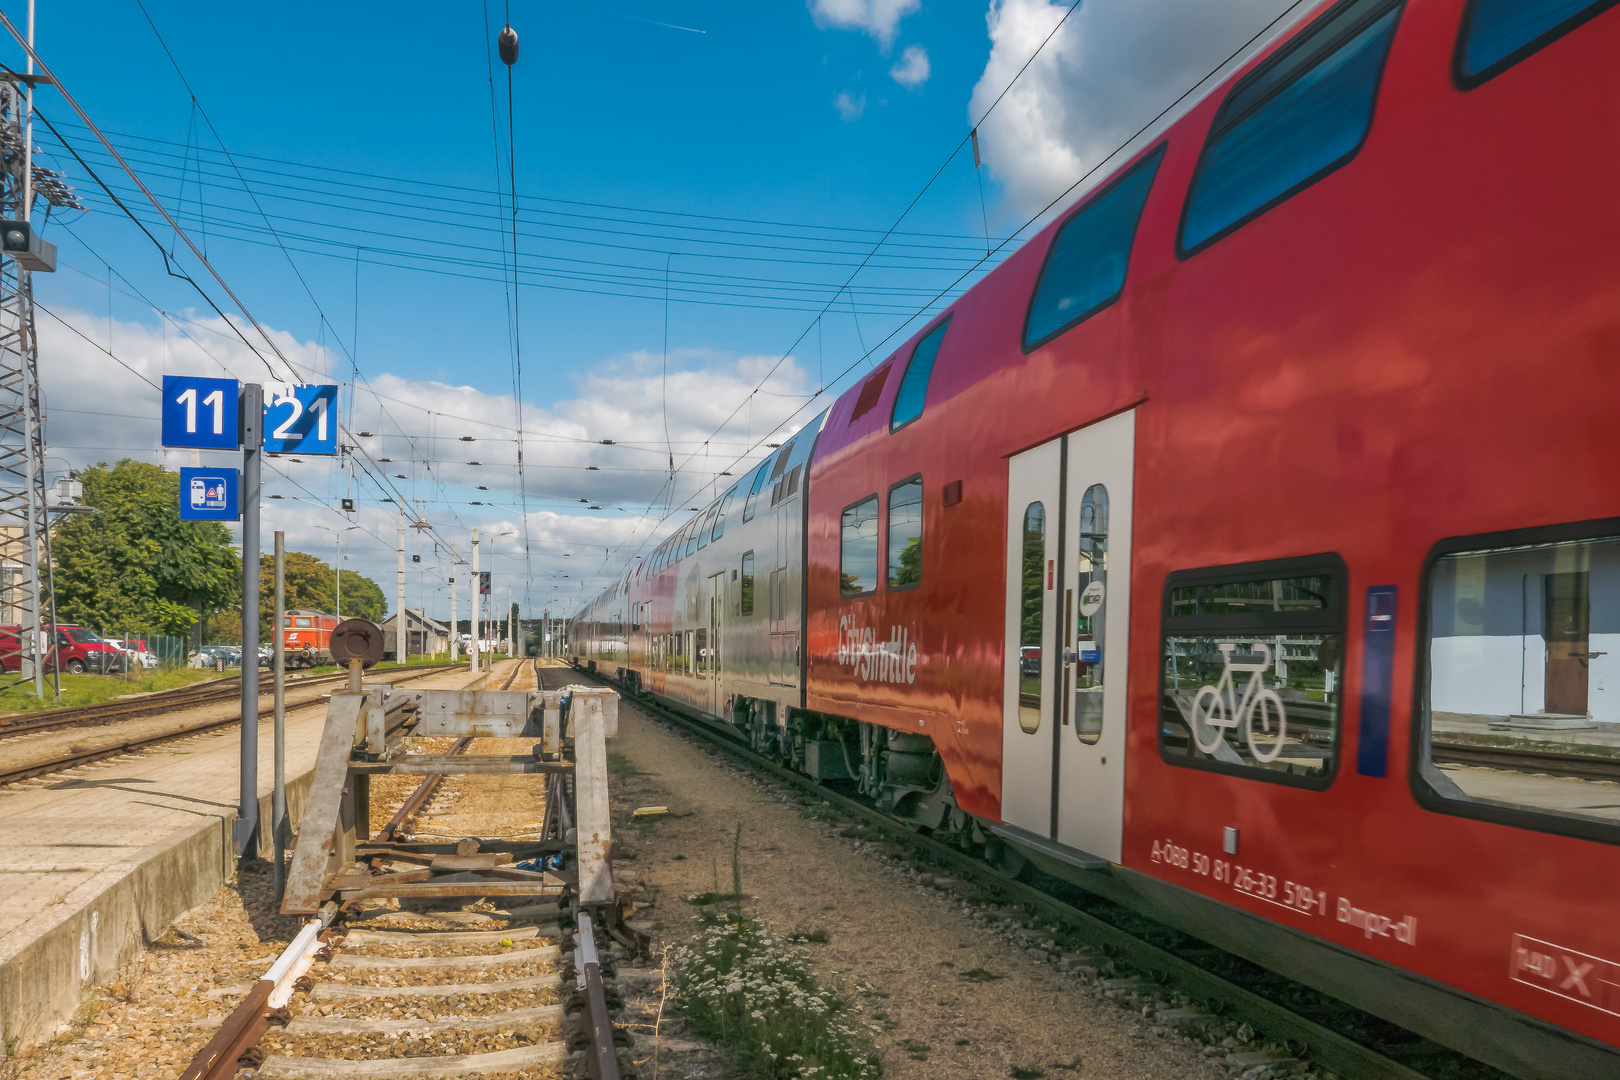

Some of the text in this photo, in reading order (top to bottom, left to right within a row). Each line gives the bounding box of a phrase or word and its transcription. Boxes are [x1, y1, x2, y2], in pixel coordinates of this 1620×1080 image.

[176, 388, 224, 435] 11
[272, 397, 328, 441] 21
[838, 614, 917, 684] CityShuttle
[1192, 852, 1210, 876] 50
[1213, 859, 1231, 884] 81
[1233, 865, 1277, 899] 26-33
[1283, 880, 1327, 916] 519-1
[1559, 955, 1595, 998] X
